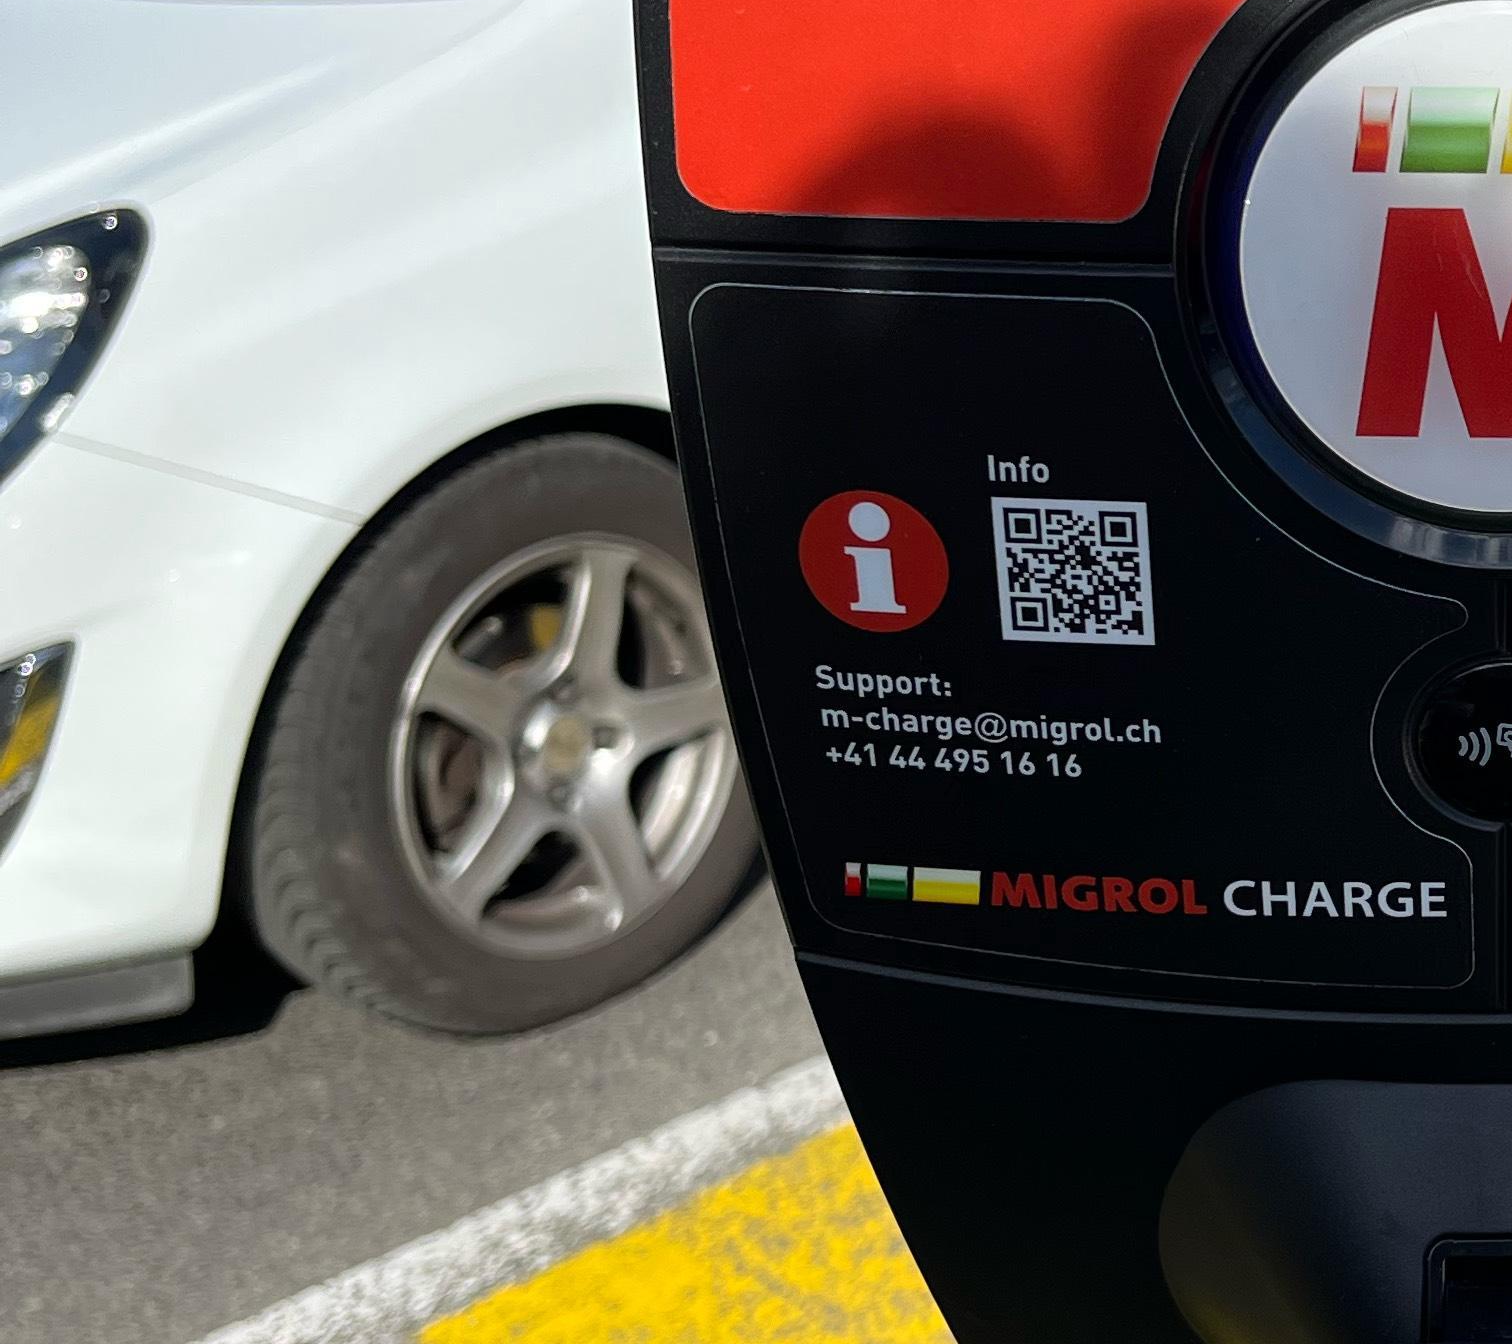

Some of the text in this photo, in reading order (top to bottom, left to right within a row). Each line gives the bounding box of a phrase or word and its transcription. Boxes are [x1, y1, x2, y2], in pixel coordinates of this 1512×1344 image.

[987, 454, 1050, 484] Info
[815, 664, 953, 699] Support:
[821, 707, 1162, 746] m-charge@migrol.ch
[825, 742, 1083, 778] +41 44 495 16 16
[991, 871, 1449, 919] MIGROL CHARGE
